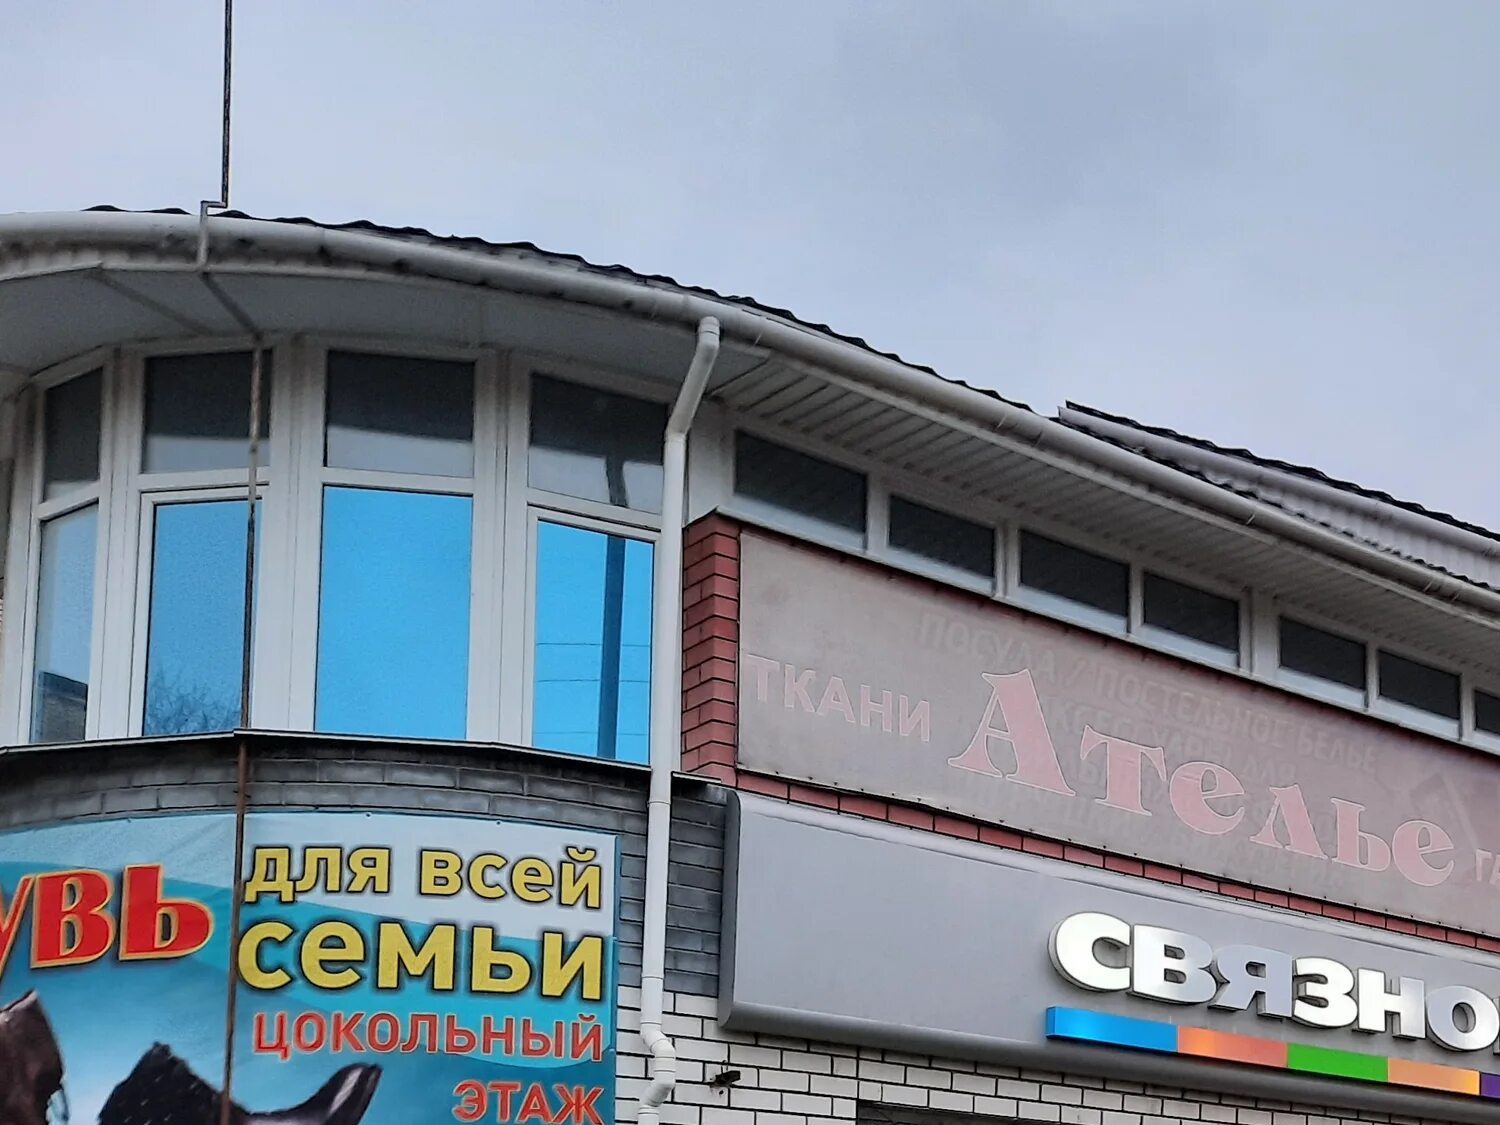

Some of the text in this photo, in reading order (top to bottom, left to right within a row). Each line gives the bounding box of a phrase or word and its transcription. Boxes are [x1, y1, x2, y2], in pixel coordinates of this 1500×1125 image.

[745, 653, 932, 743] ТКАНИ
[947, 668, 1456, 887] Ателье
[243, 845, 602, 910] для всей
[236, 919, 604, 1001] семьи
[252, 1009, 604, 1063] ЦОКОЛЬНЫЙ
